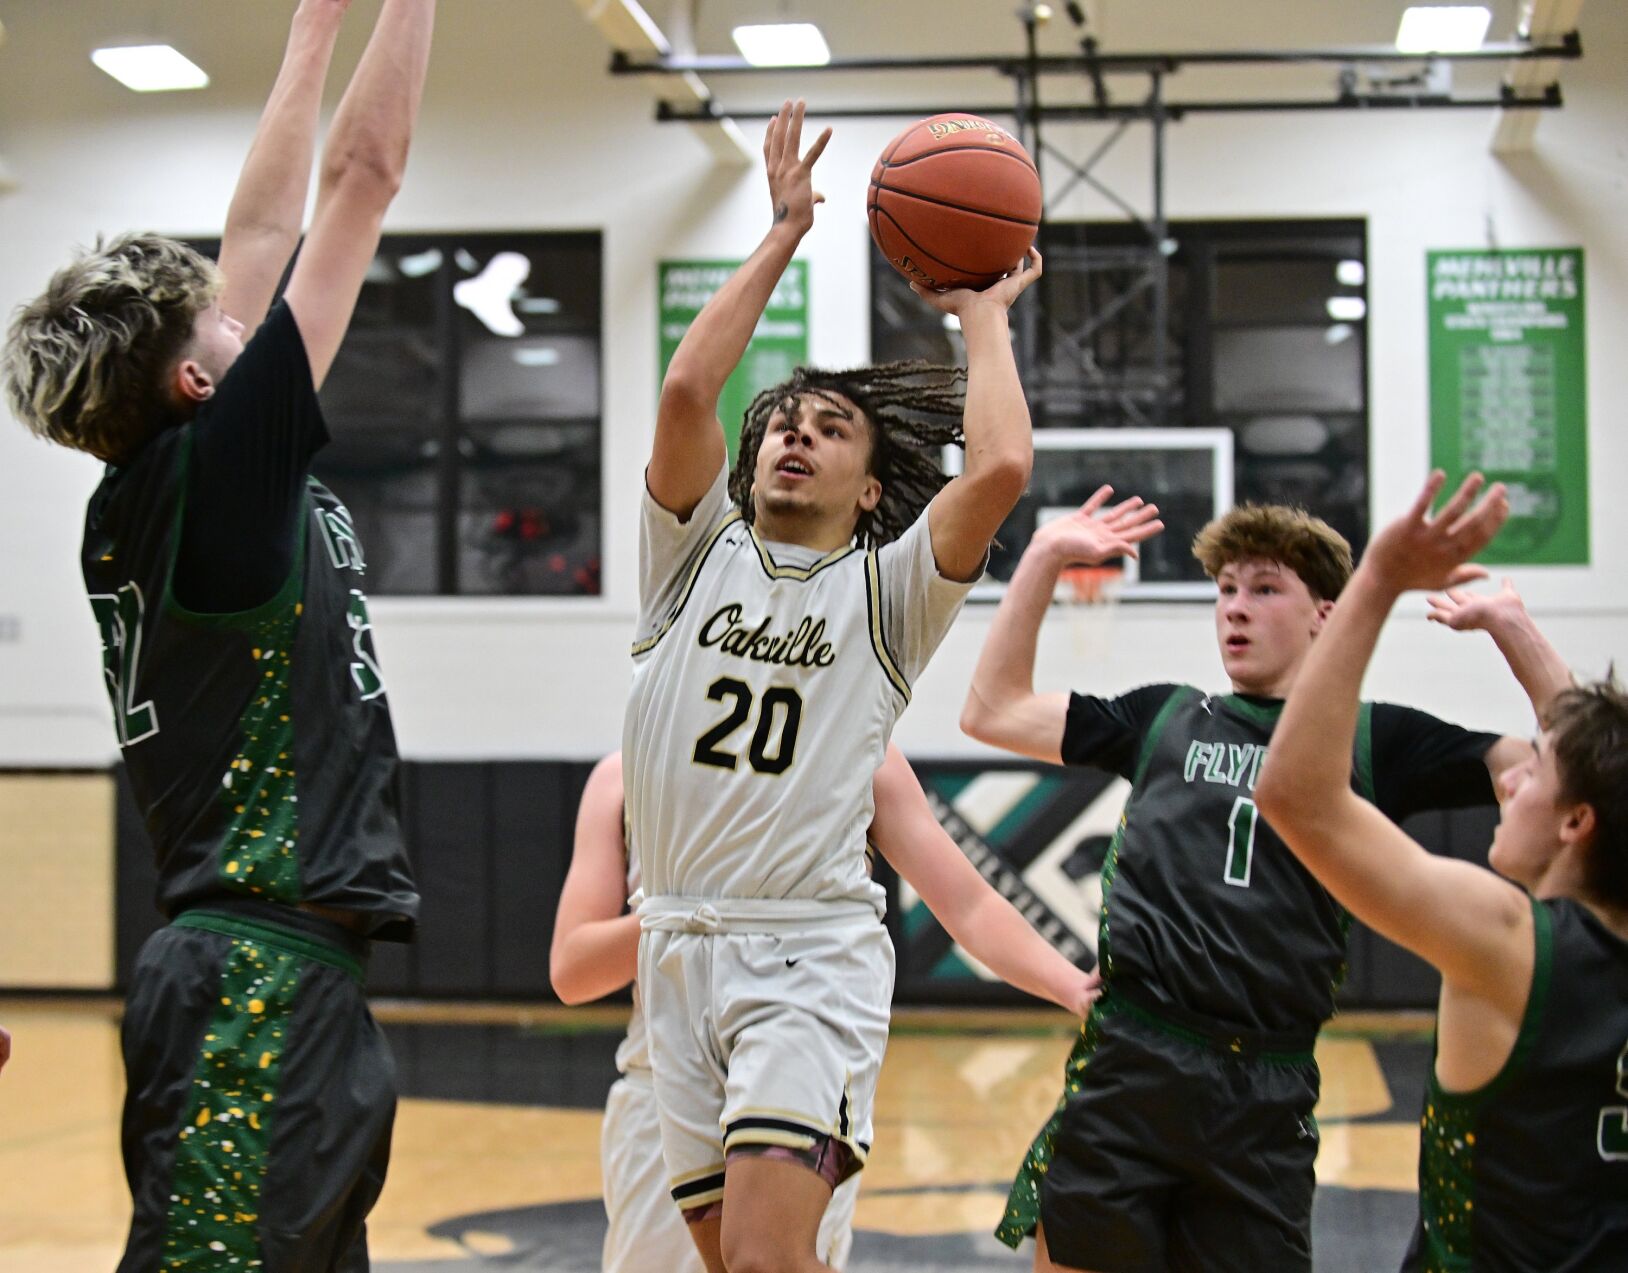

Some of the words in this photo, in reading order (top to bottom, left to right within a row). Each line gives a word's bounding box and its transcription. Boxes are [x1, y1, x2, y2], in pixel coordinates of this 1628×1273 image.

[1434, 279, 1578, 300] PANTHERS
[698, 602, 836, 668] Oakville
[690, 674, 805, 776] 20
[1224, 796, 1258, 888] 1
